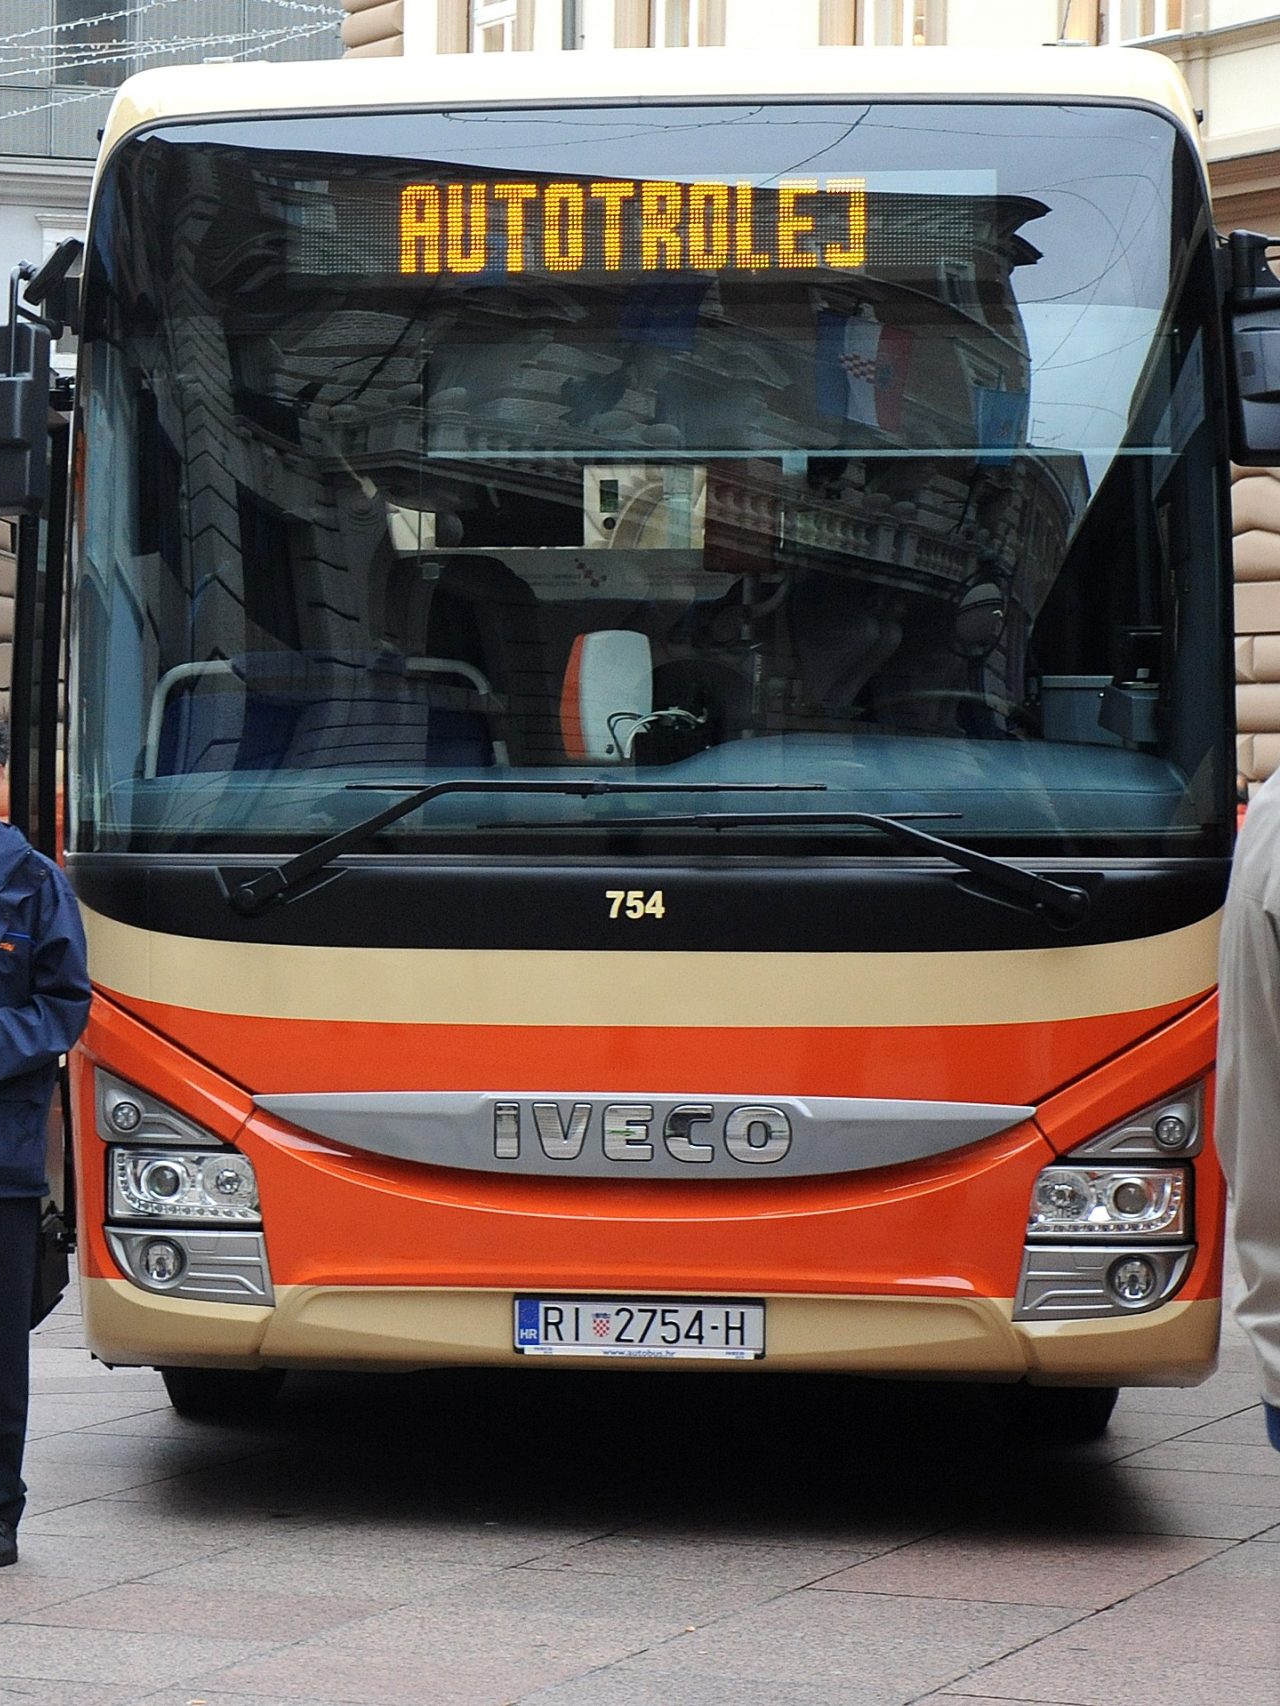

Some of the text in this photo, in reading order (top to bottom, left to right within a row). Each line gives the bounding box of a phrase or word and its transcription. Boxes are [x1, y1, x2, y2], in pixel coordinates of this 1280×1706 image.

[399, 178, 867, 273] AUTOTROLEJ
[605, 890, 666, 919] 754
[494, 1101, 793, 1164] IVECO
[519, 1328, 538, 1340] HR
[543, 1306, 745, 1346] RI 2754-H
